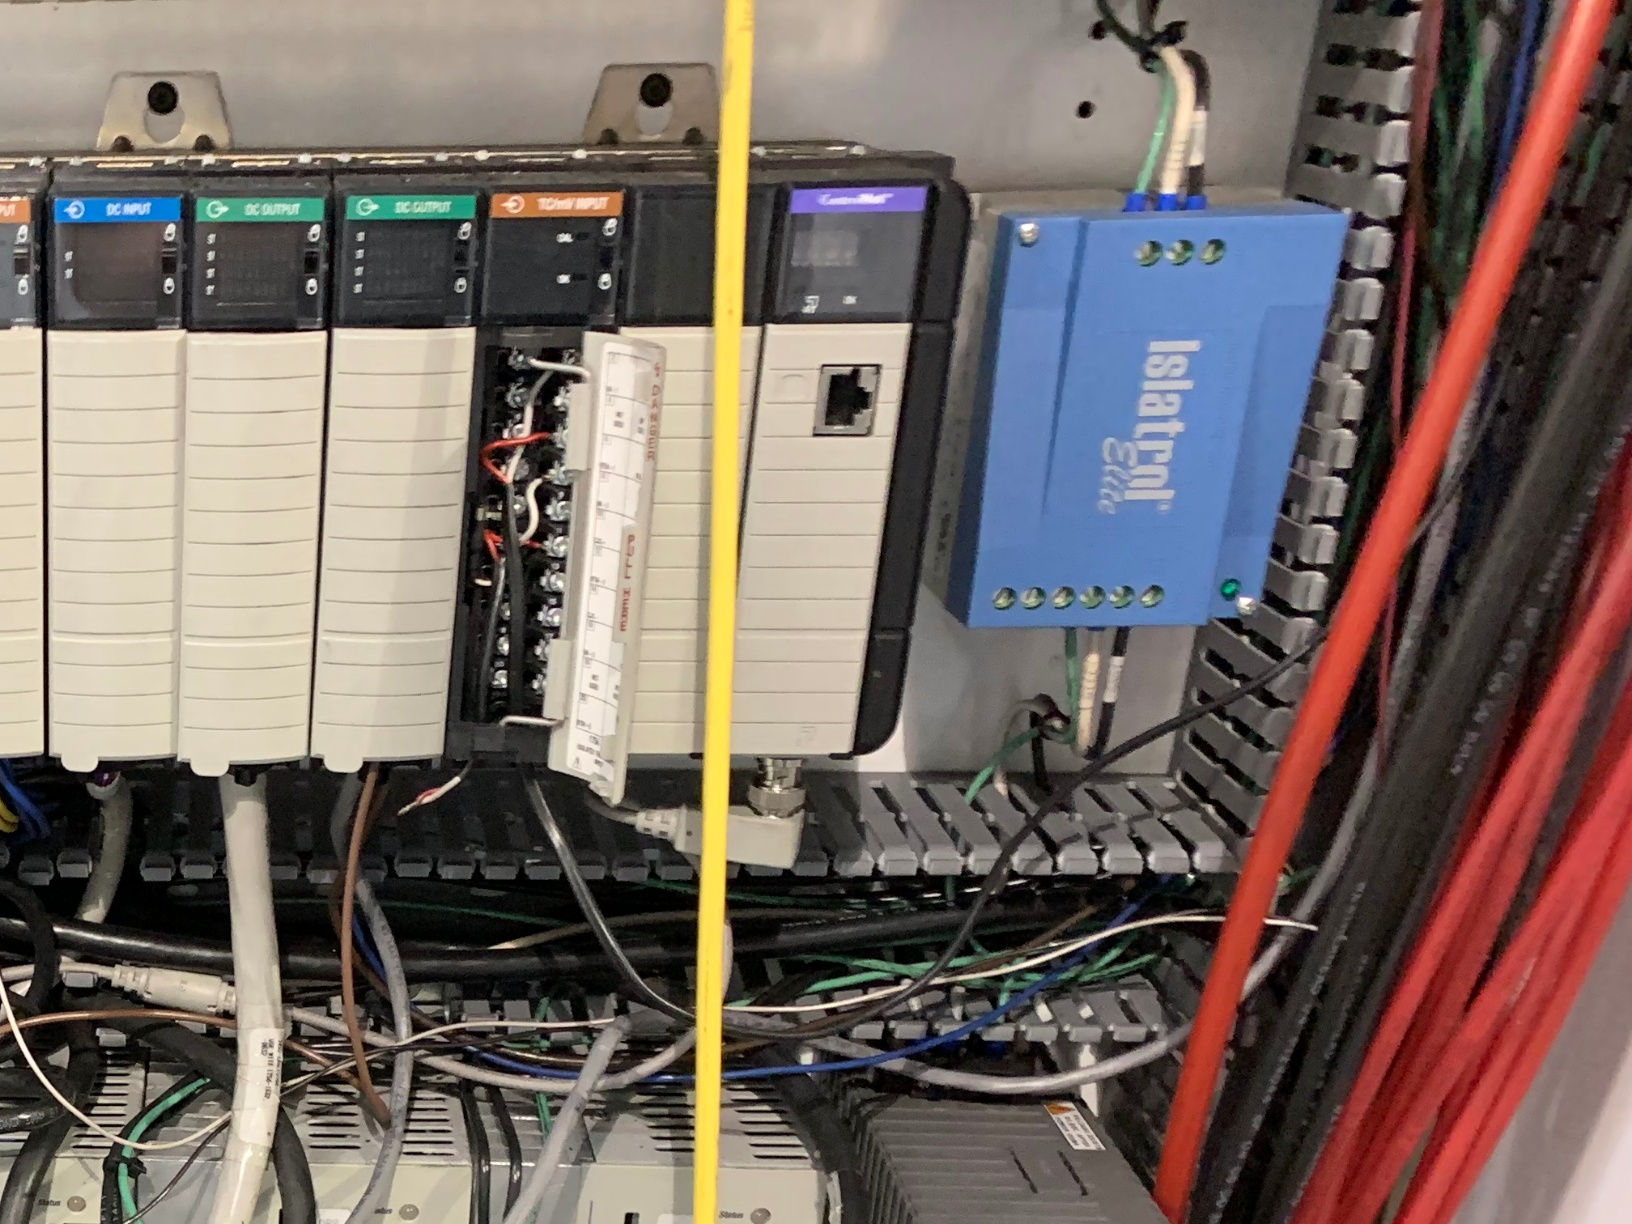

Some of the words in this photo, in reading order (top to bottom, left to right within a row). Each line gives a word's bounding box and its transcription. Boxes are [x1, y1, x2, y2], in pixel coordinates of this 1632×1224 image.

[105, 204, 120, 216] DC
[121, 203, 152, 216] INPUT
[245, 204, 260, 216] DC
[261, 203, 301, 215] OUTPUT
[394, 202, 409, 214] DC
[411, 200, 452, 213] OUTPUT
[576, 197, 609, 210] INPUT
[646, 384, 661, 462] DANGER
[624, 534, 636, 580] PULL
[619, 587, 631, 632] HERE
[38, 1199, 61, 1207] Status
[718, 1211, 744, 1219] Status
